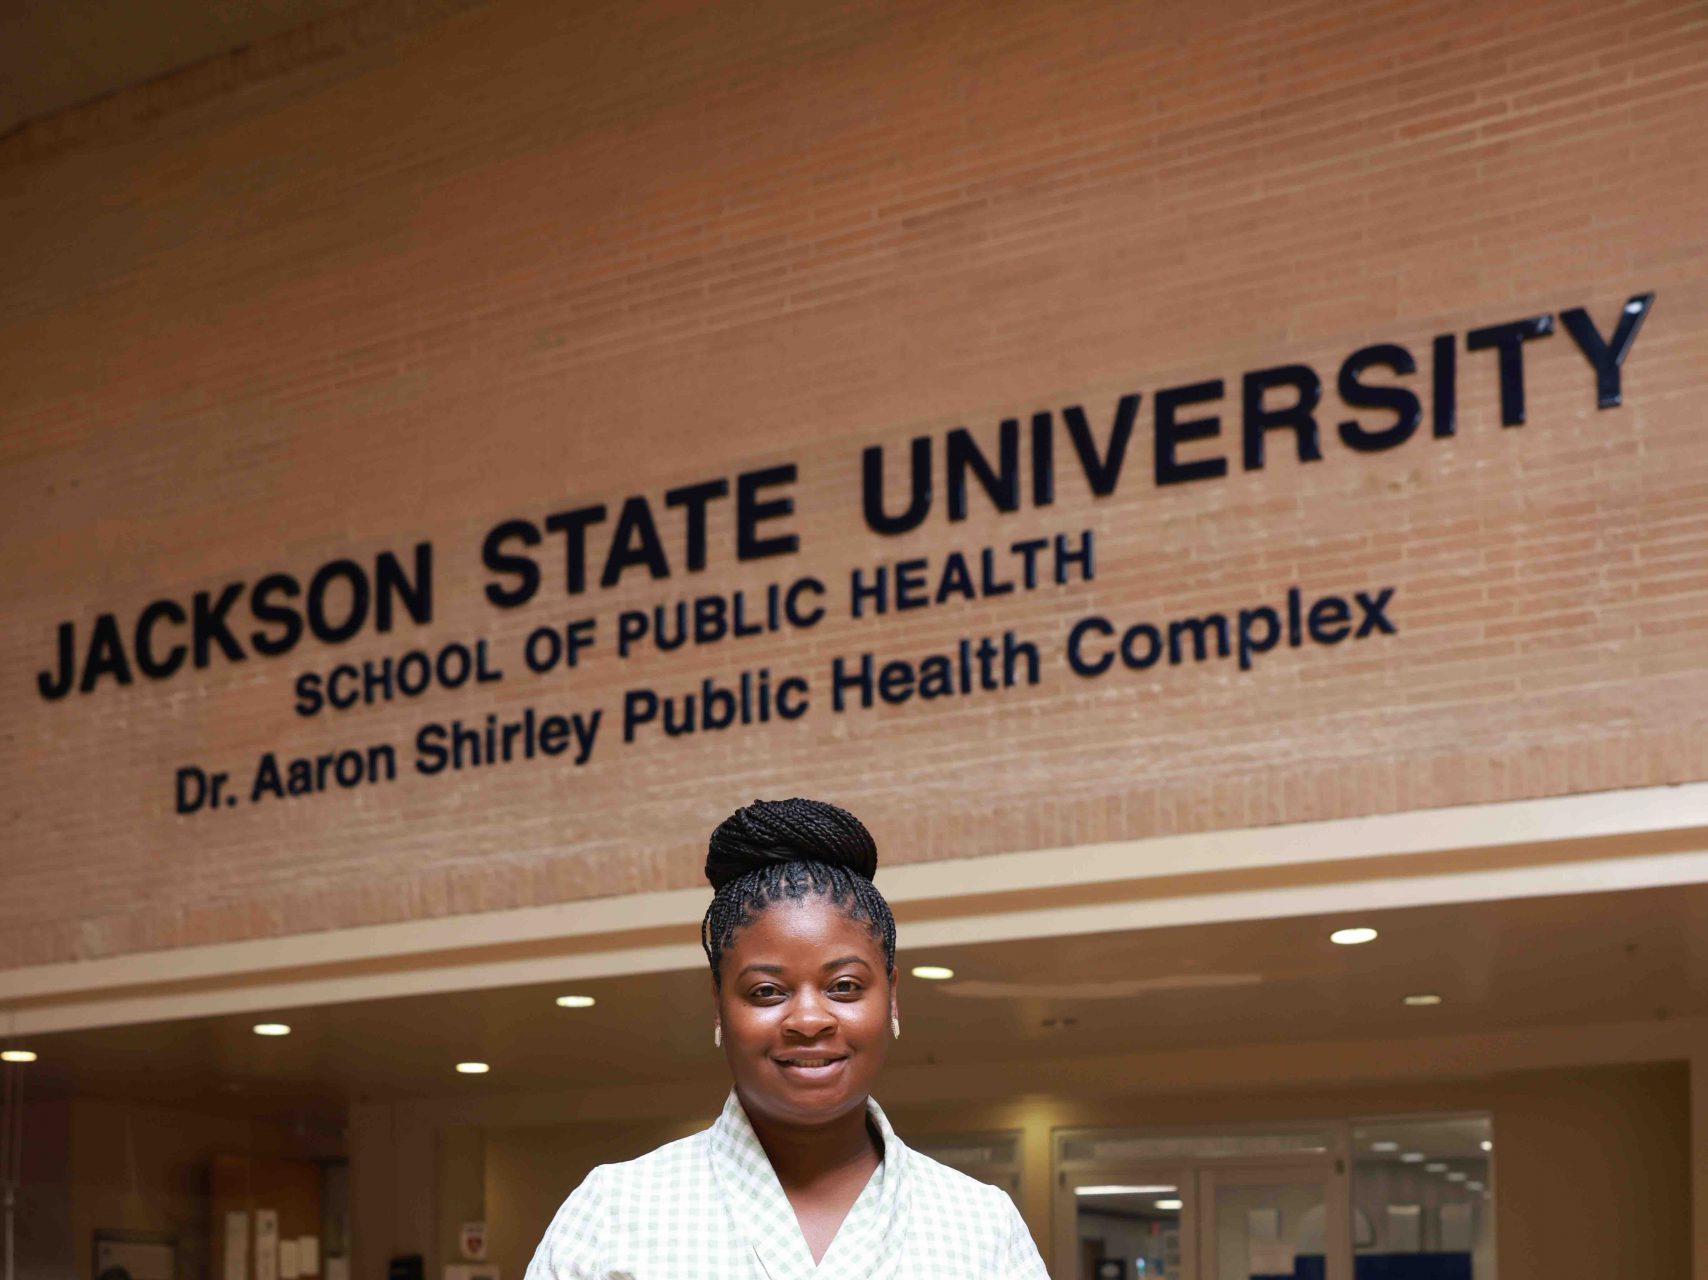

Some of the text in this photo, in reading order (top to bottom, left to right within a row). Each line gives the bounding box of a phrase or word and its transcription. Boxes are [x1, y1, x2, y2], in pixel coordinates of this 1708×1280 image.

[35, 292, 1656, 702] JACKSON STATE UNIVERSITY
[174, 586, 1397, 816] Dr. Aaron Shirley Public Health Complex
[294, 529, 1095, 718] SCHOOL OF PUBLIC HEALTH
